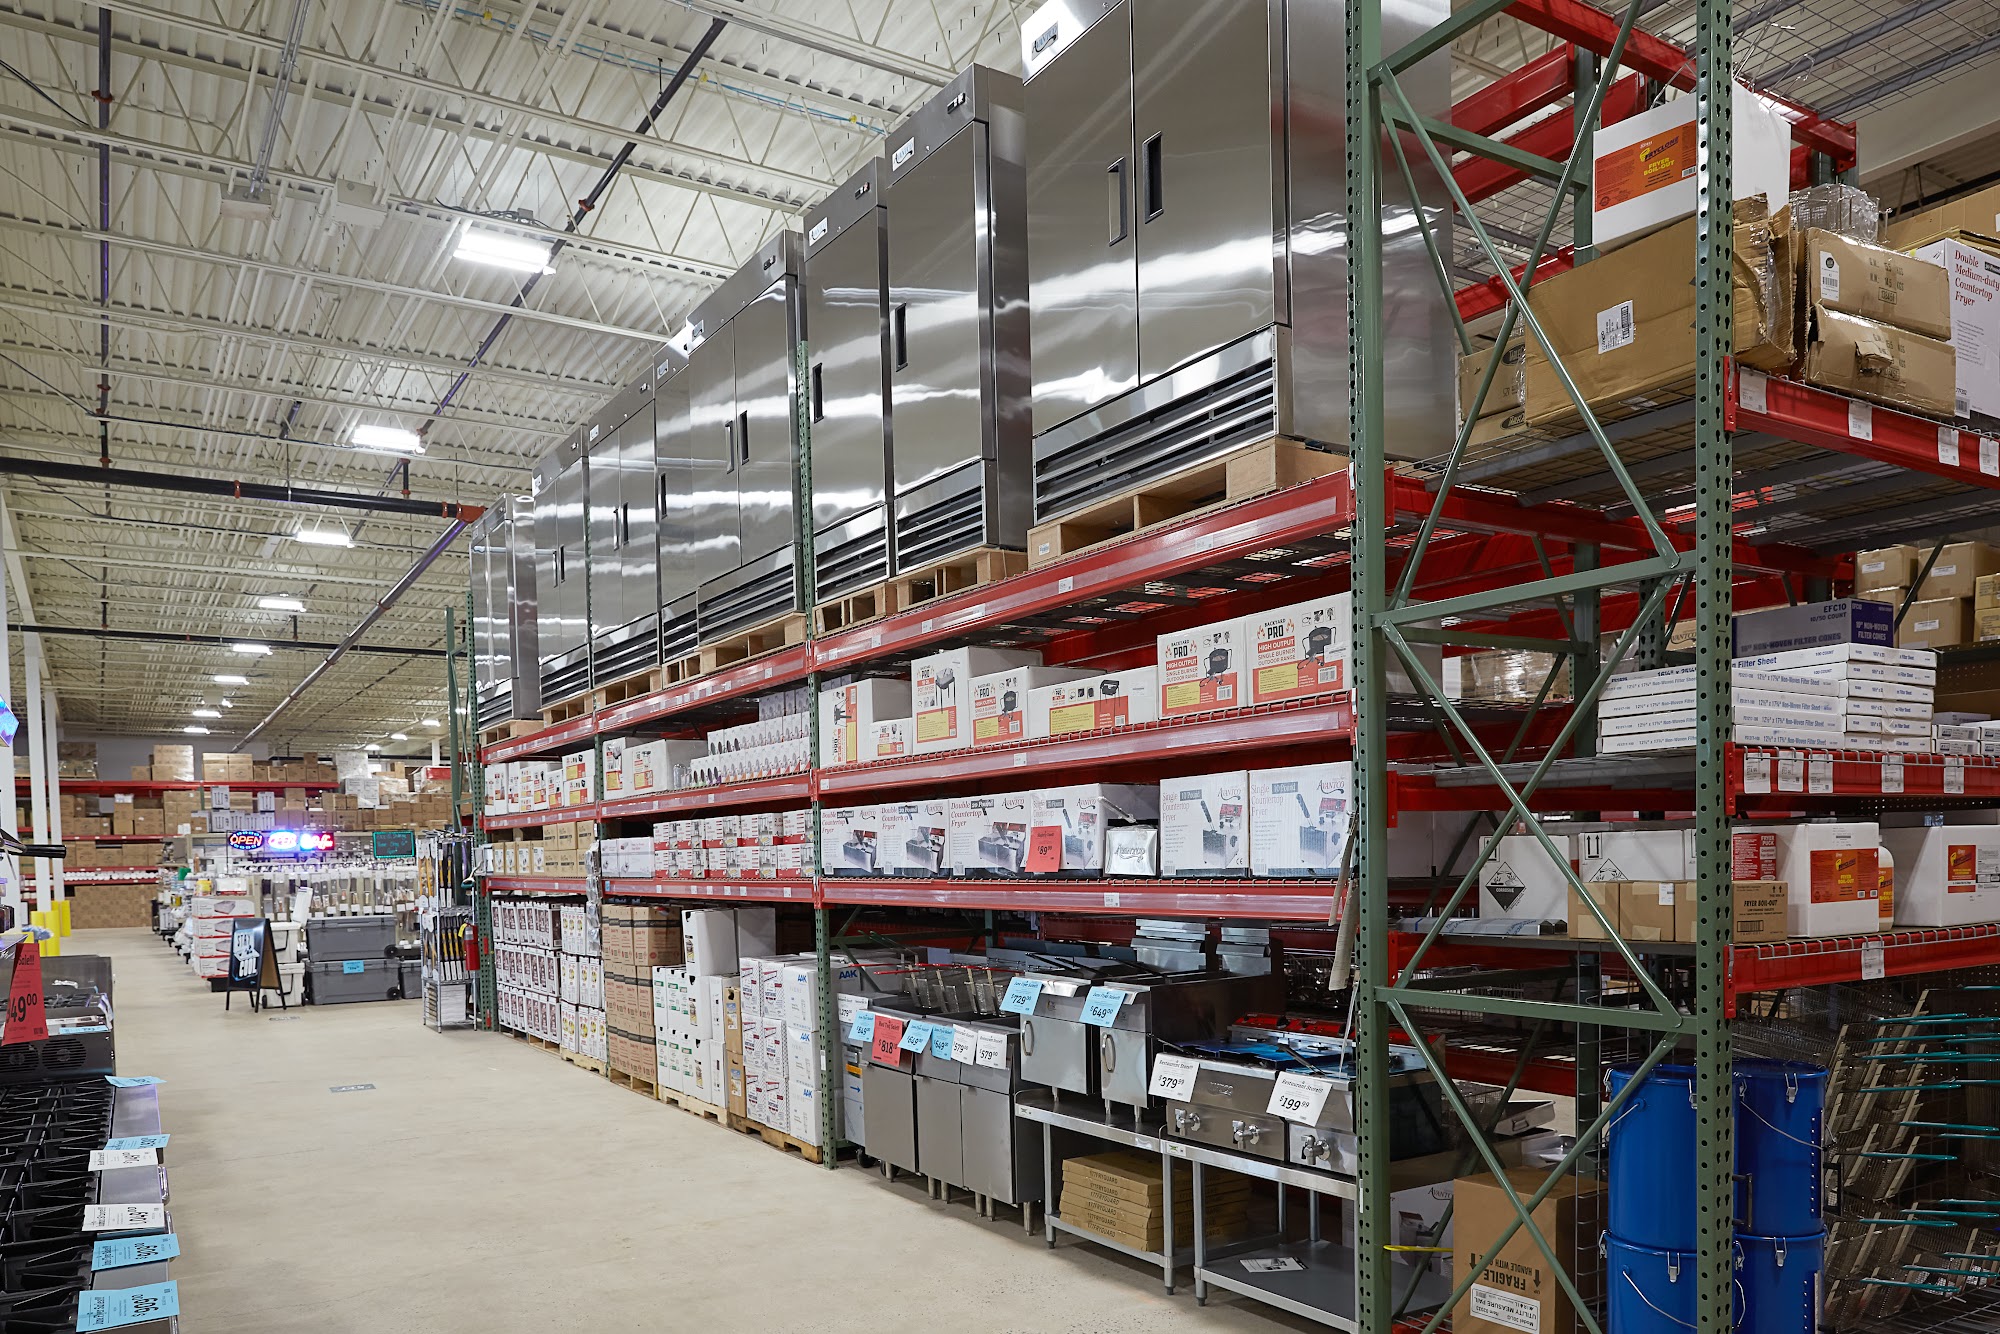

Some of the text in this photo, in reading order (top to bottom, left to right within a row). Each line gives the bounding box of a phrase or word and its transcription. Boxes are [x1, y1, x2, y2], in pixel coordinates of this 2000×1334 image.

[1643, 160, 1675, 176] BOIL-OUT
[1648, 157, 1670, 169] FRYER
[1954, 249, 1979, 268] Double
[1954, 263, 2000, 291] Medium-duty
[1954, 277, 1993, 302] Countertop
[1954, 291, 1976, 306] Fryer
[1823, 603, 1847, 613] EFC10
[1827, 611, 1847, 621] COUNT
[1264, 618, 1286, 628] BACKYARD
[1864, 621, 1889, 632] NON-WOVEN
[1267, 624, 1284, 639] PRO
[1857, 631, 1886, 641] FILTER CONES
[1171, 639, 1190, 647] BACKYARD
[1258, 638, 1295, 651] HIGH OUTPUT
[1753, 632, 1841, 651] NON-WOVEN FILTER CONES
[1173, 645, 1188, 658] PRO
[1276, 648, 1296, 658] BURNER
[1166, 657, 1197, 669] HIGH OUTPUT
[1257, 653, 1296, 666] OUTDOOR RANGE
[1737, 656, 1777, 669] Filter Sheet
[921, 669, 930, 679] PRO
[1181, 667, 1198, 676] BURNER
[1165, 675, 1184, 683] OUTDOOR
[1780, 676, 1820, 686] Non-Woven Filter Sheet
[979, 688, 990, 698] PRO
[1781, 701, 1820, 711] Non-Woven Filter Sheet
[1785, 718, 1805, 726] Non-Woven
[1805, 719, 1814, 727] Filter
[1787, 737, 1807, 745] Non-Woven
[1816, 738, 1826, 746] Sheet
[1250, 784, 1270, 794] Single
[1280, 782, 1296, 792] Pound
[1316, 779, 1345, 794] AVANTCO
[1162, 791, 1178, 801] Single
[1217, 787, 1242, 800] AVANTCO
[1251, 795, 1284, 805] Countertop
[951, 801, 970, 810] Double
[1162, 802, 1190, 812] Countertop
[822, 812, 837, 820] Double
[881, 807, 898, 815] Double
[950, 810, 982, 819] Countertop
[1251, 806, 1268, 817] Fryer
[881, 815, 908, 823] Countertop
[1162, 812, 1176, 822] Fryer
[822, 819, 846, 828] Countertop
[881, 822, 896, 831] Fryer
[951, 818, 967, 828] Fryer
[822, 826, 835, 834] Fryer
[229, 834, 263, 846] OPEN
[797, 974, 807, 982] AAK
[839, 969, 858, 979] AAK
[800, 1033, 810, 1042] AAK
[1159, 1059, 1180, 1068] Restaurant
[1281, 1079, 1307, 1089] Restaurant
[803, 1089, 813, 1099] AAK
[1495, 1259, 1509, 1270] WITH
[1510, 1262, 1533, 1276] HANDLE
[1483, 1268, 1526, 1290] FRAGILE
[1474, 1297, 1487, 1307] PAIL
[1486, 1300, 1515, 1313] MEASURE
[1515, 1308, 1537, 1320] UTILITY
[1519, 1318, 1534, 1327] Model
